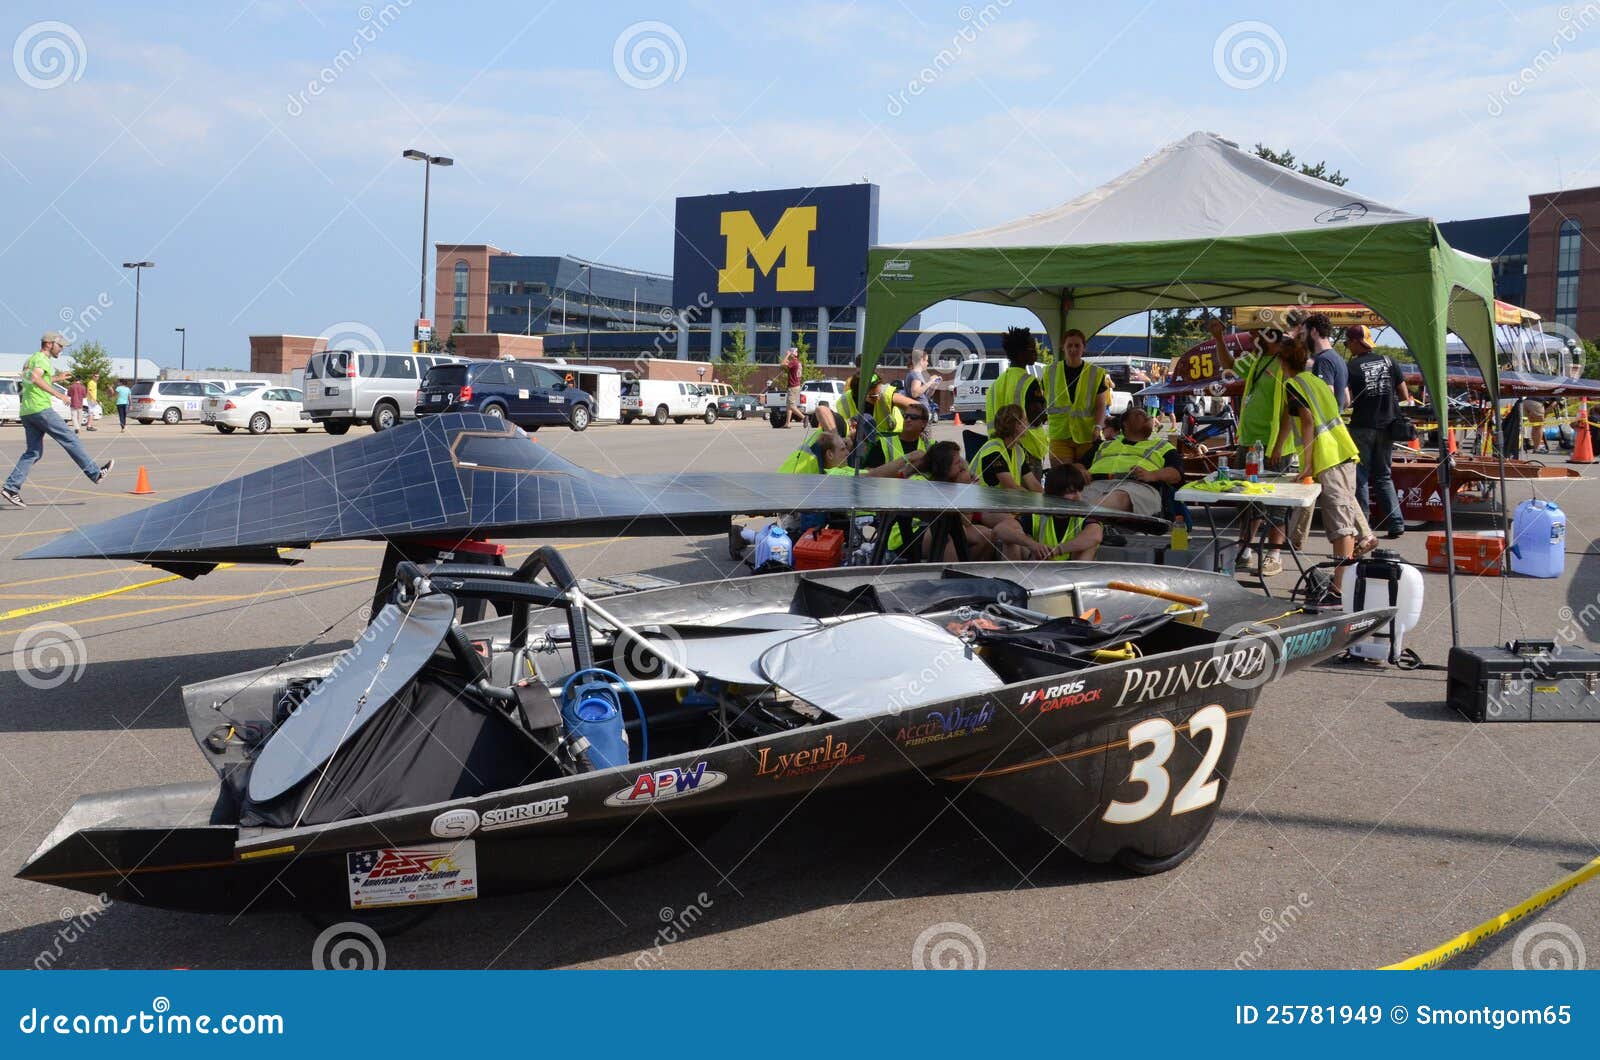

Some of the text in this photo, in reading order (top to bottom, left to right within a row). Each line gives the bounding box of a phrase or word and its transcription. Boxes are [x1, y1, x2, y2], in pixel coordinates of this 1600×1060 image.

[718, 206, 817, 293] M
[507, 367, 514, 379] 9
[1190, 354, 1213, 379] 35
[447, 393, 454, 405] 9
[969, 386, 980, 394] 32
[1276, 626, 1337, 663] SIEMENS
[1113, 643, 1267, 708] PRINCIPIA
[1019, 680, 1086, 708] HARRIS
[1040, 688, 1103, 713] CAPROCK
[757, 734, 848, 778] Lyerla
[1102, 704, 1228, 823] 32
[629, 761, 708, 800] APW
[481, 796, 568, 827] STRUT
[361, 870, 461, 887] American Solar Challenge
